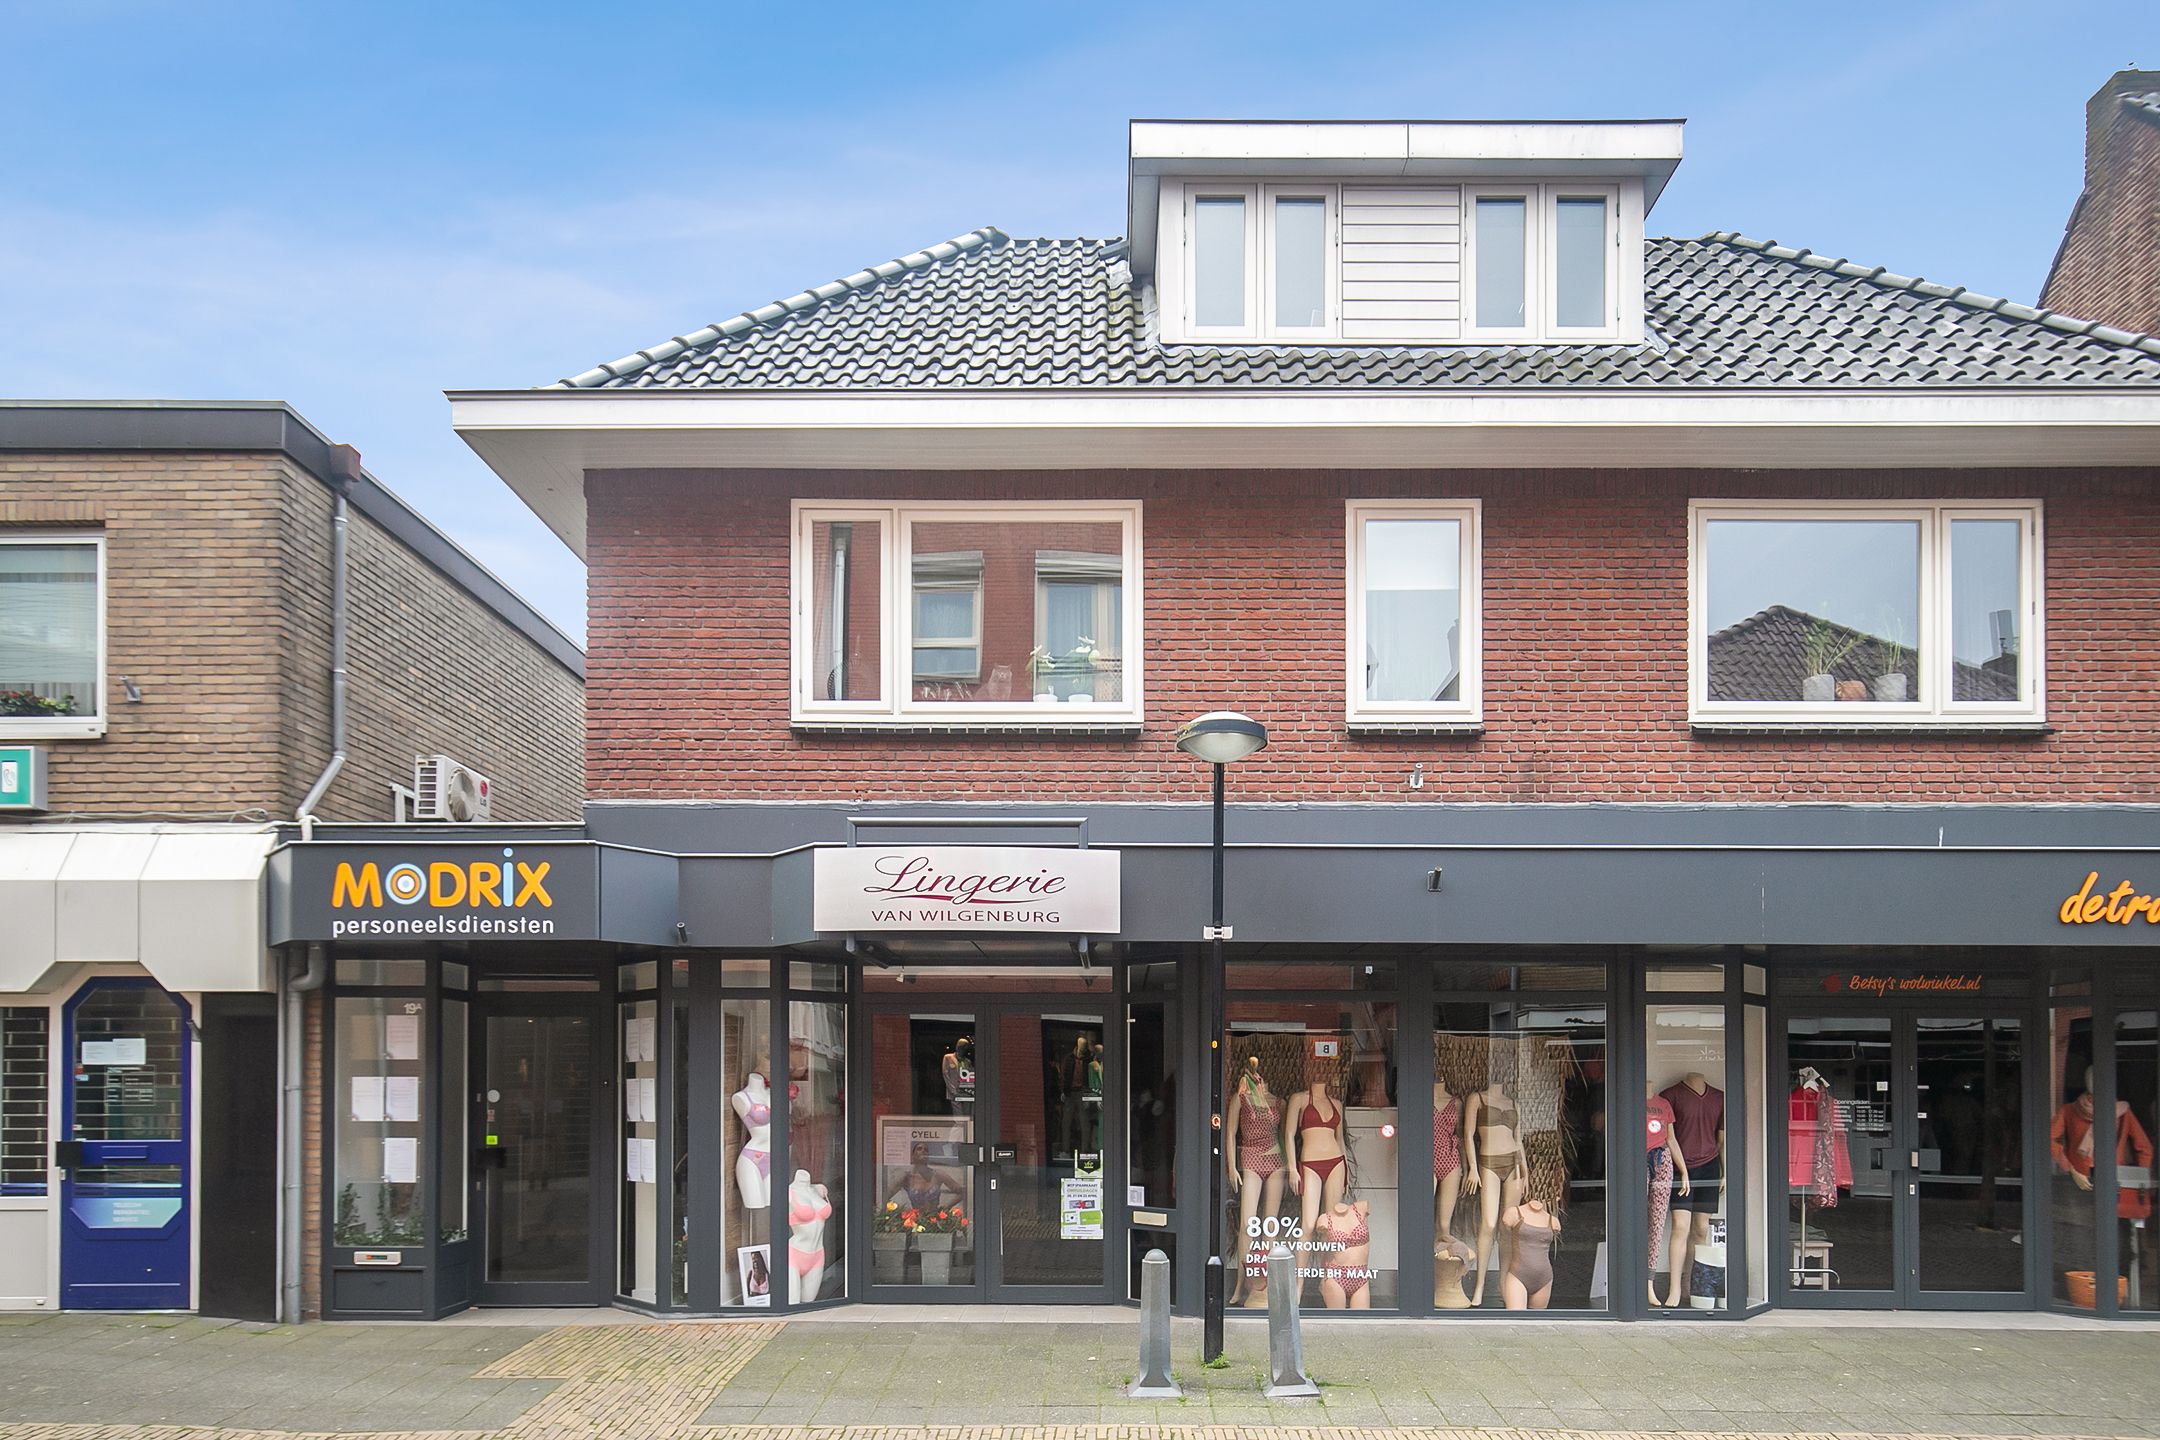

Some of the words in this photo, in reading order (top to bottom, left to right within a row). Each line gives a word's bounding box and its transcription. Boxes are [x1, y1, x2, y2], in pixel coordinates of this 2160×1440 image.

[864, 855, 1066, 905] Lingerie
[871, 910, 912, 922] VAN
[919, 910, 1060, 923] WILGENBURG
[332, 915, 554, 938] personeelsdiensten
[1849, 975, 1896, 997] Betsy's
[911, 1131, 940, 1139] CYELL
[1246, 1216, 1304, 1238] 80%
[1288, 1241, 1346, 1252] VROUWEN
[1246, 1267, 1260, 1277] DE
[1327, 1268, 1342, 1278] BH
[1346, 1269, 1379, 1279] MAAT
